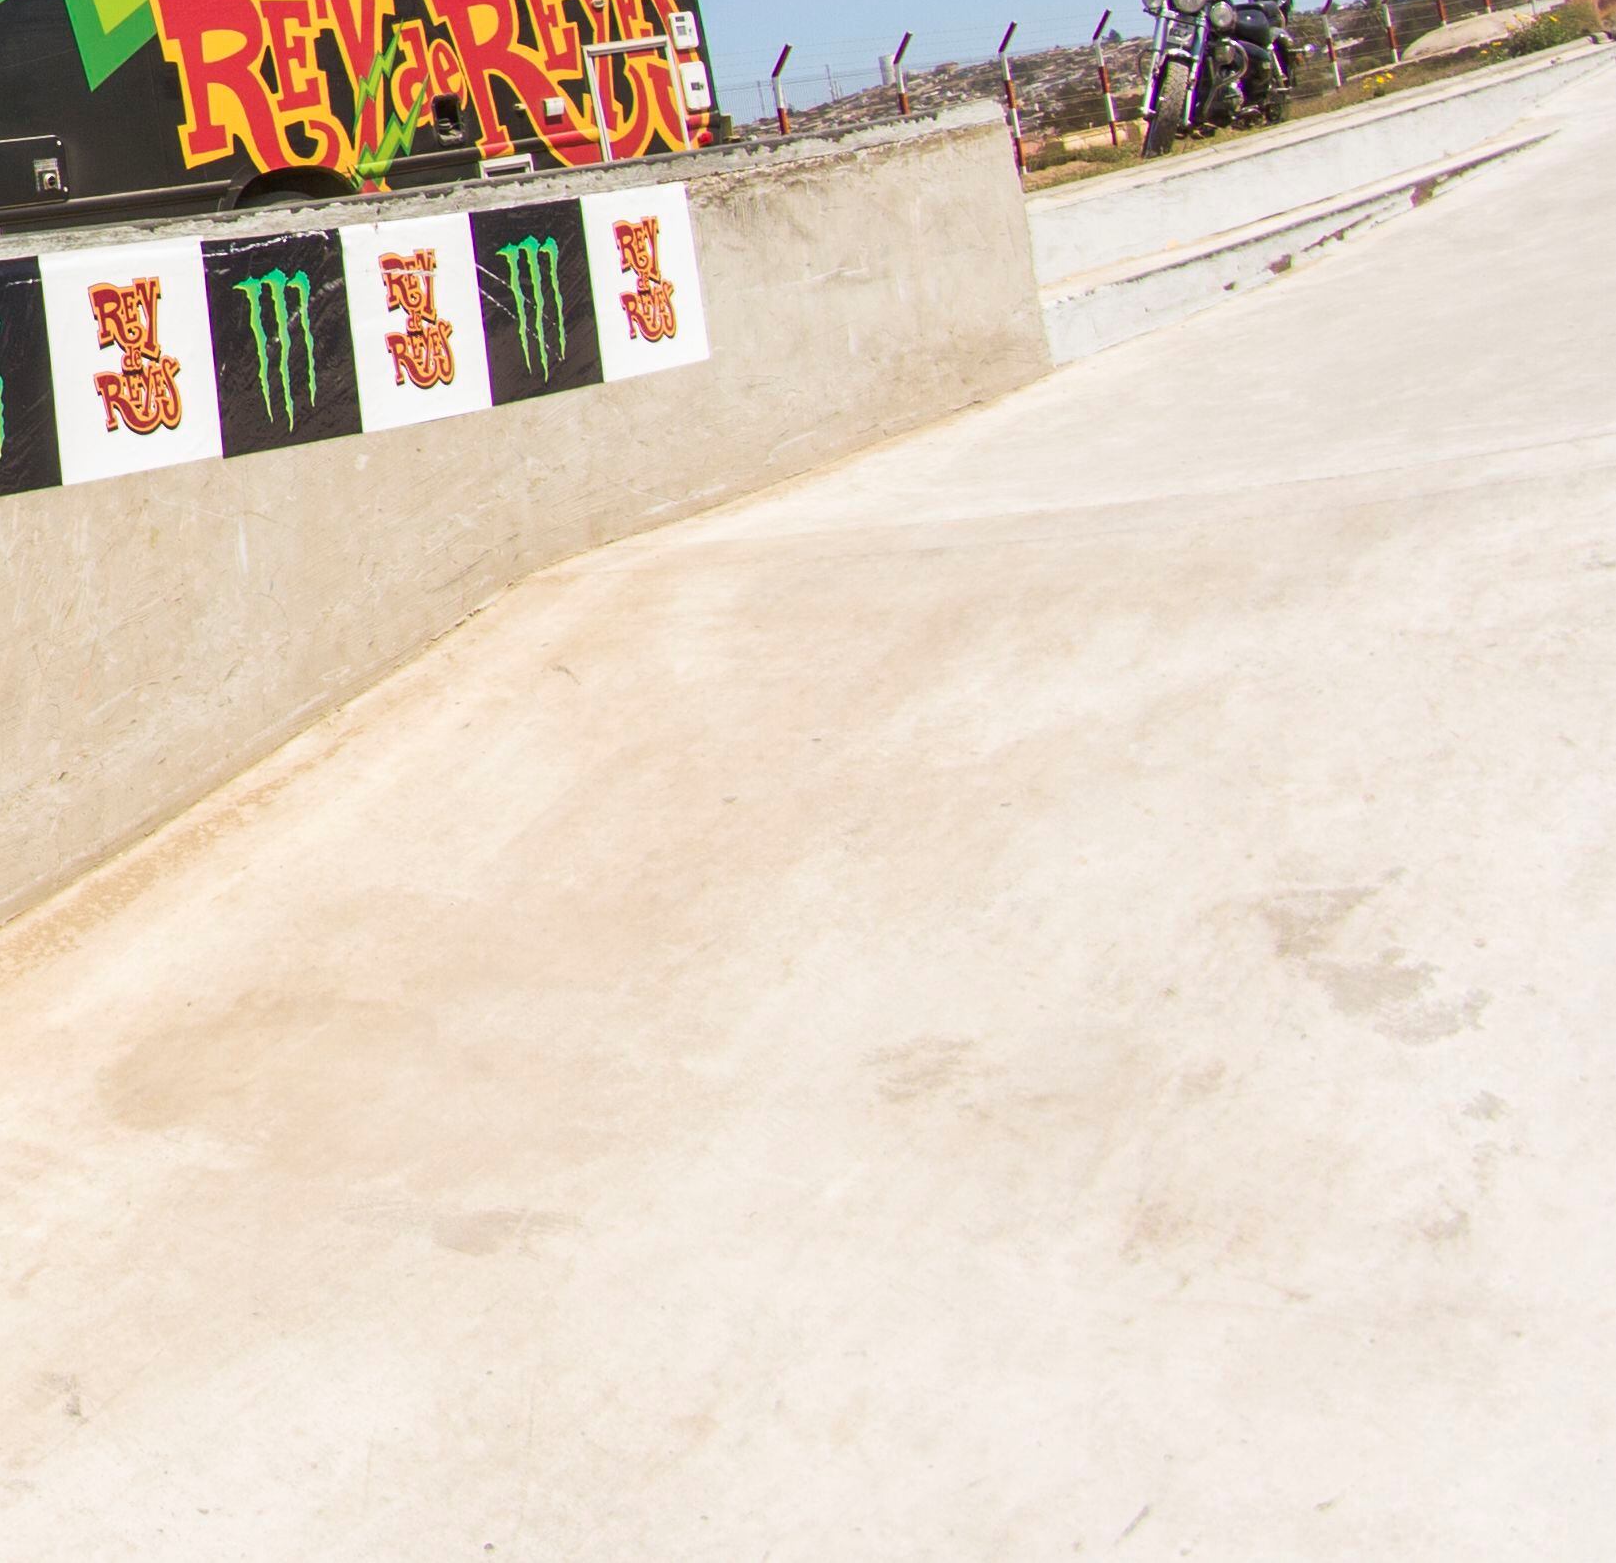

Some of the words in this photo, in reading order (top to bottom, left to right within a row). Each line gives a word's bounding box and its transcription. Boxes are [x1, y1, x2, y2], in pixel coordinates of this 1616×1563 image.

[395, 22, 465, 125] de
[612, 216, 660, 281] REY
[88, 276, 161, 359] REY
[378, 249, 436, 322] REY
[619, 280, 677, 340] REYES
[122, 346, 142, 370] de
[385, 318, 454, 387] REYES
[94, 355, 182, 433] REYES
